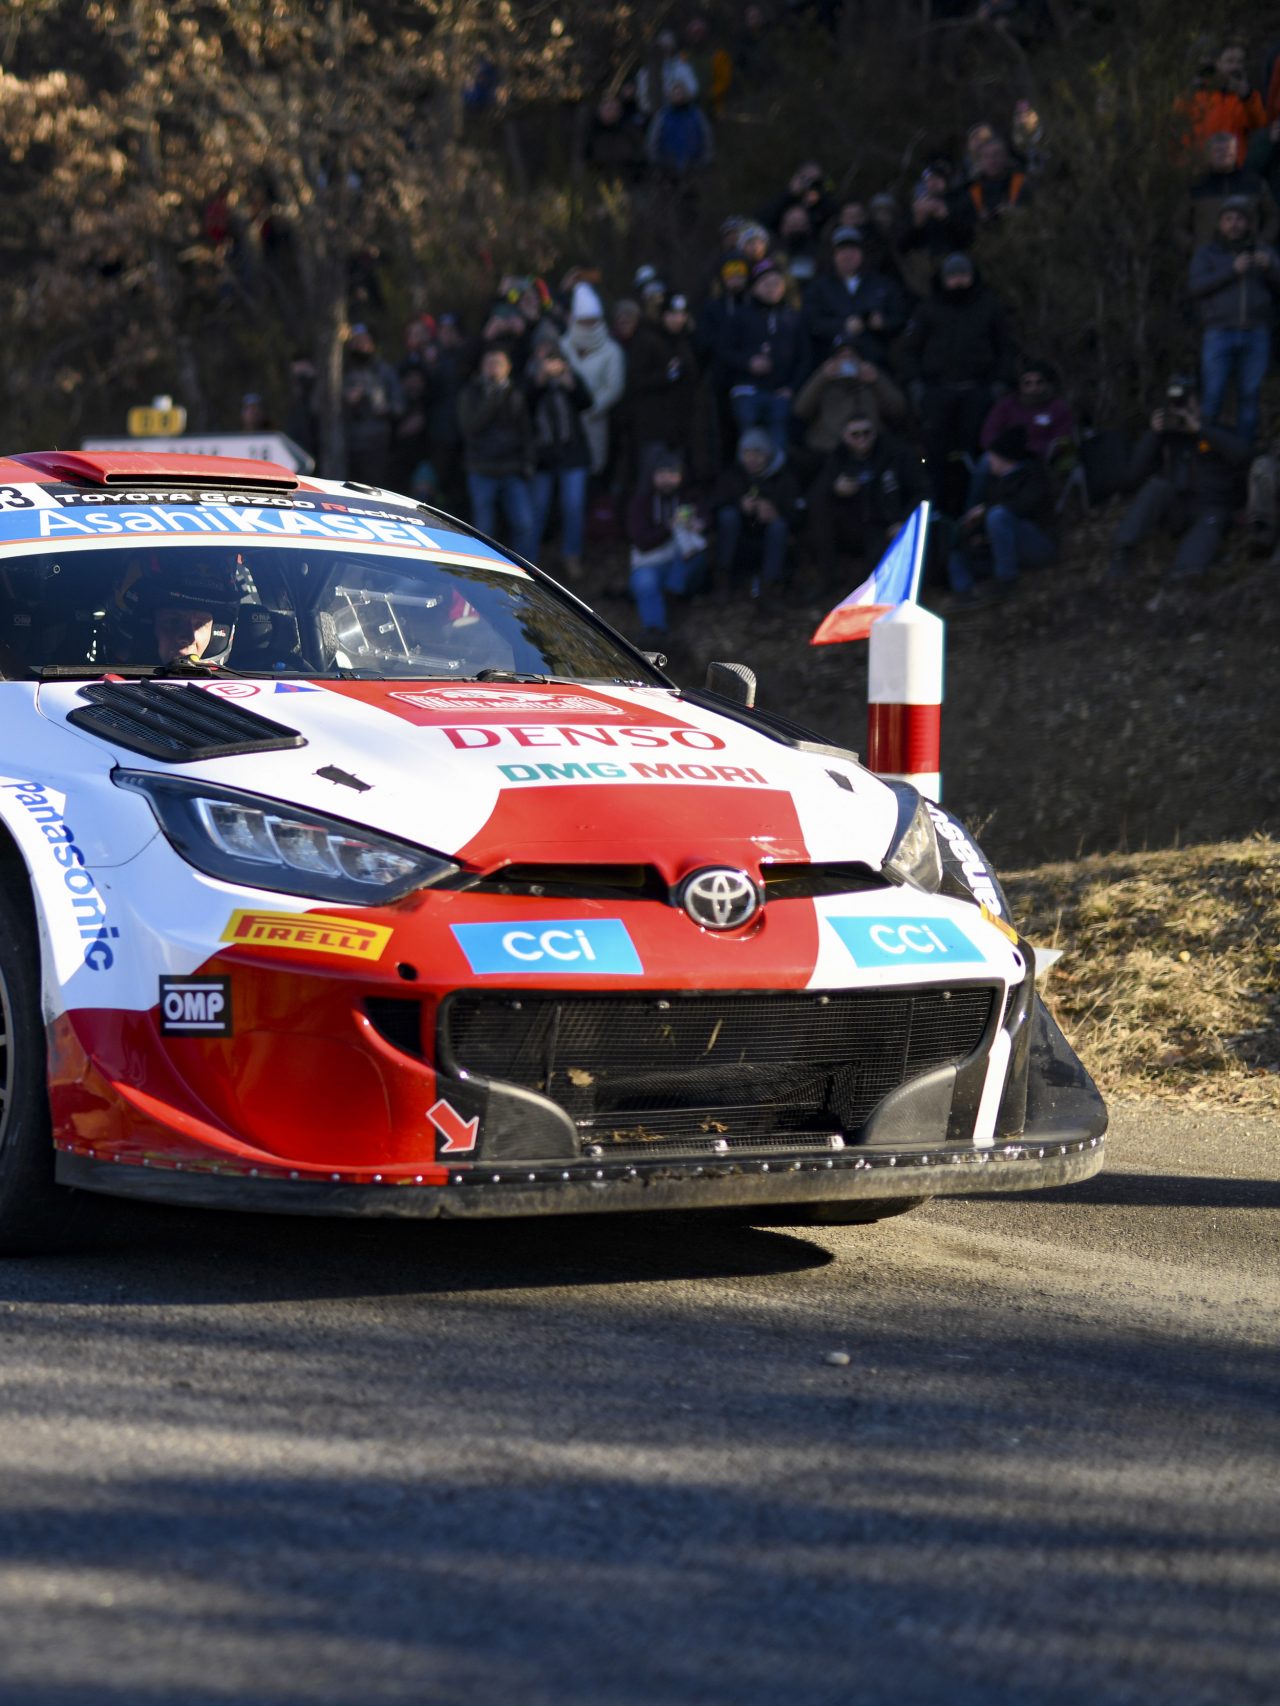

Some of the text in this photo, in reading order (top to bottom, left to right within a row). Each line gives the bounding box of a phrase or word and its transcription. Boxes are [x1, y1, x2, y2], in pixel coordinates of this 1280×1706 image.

[54, 493, 425, 526] TOYOTA GAZOO Racing
[39, 507, 442, 549] AsahiKASEI
[439, 726, 726, 751] DENSO
[496, 762, 769, 784] DMG MORI
[0, 782, 120, 971] Panasonic
[234, 915, 378, 951] PIRELLI
[164, 992, 225, 1021] OMP
